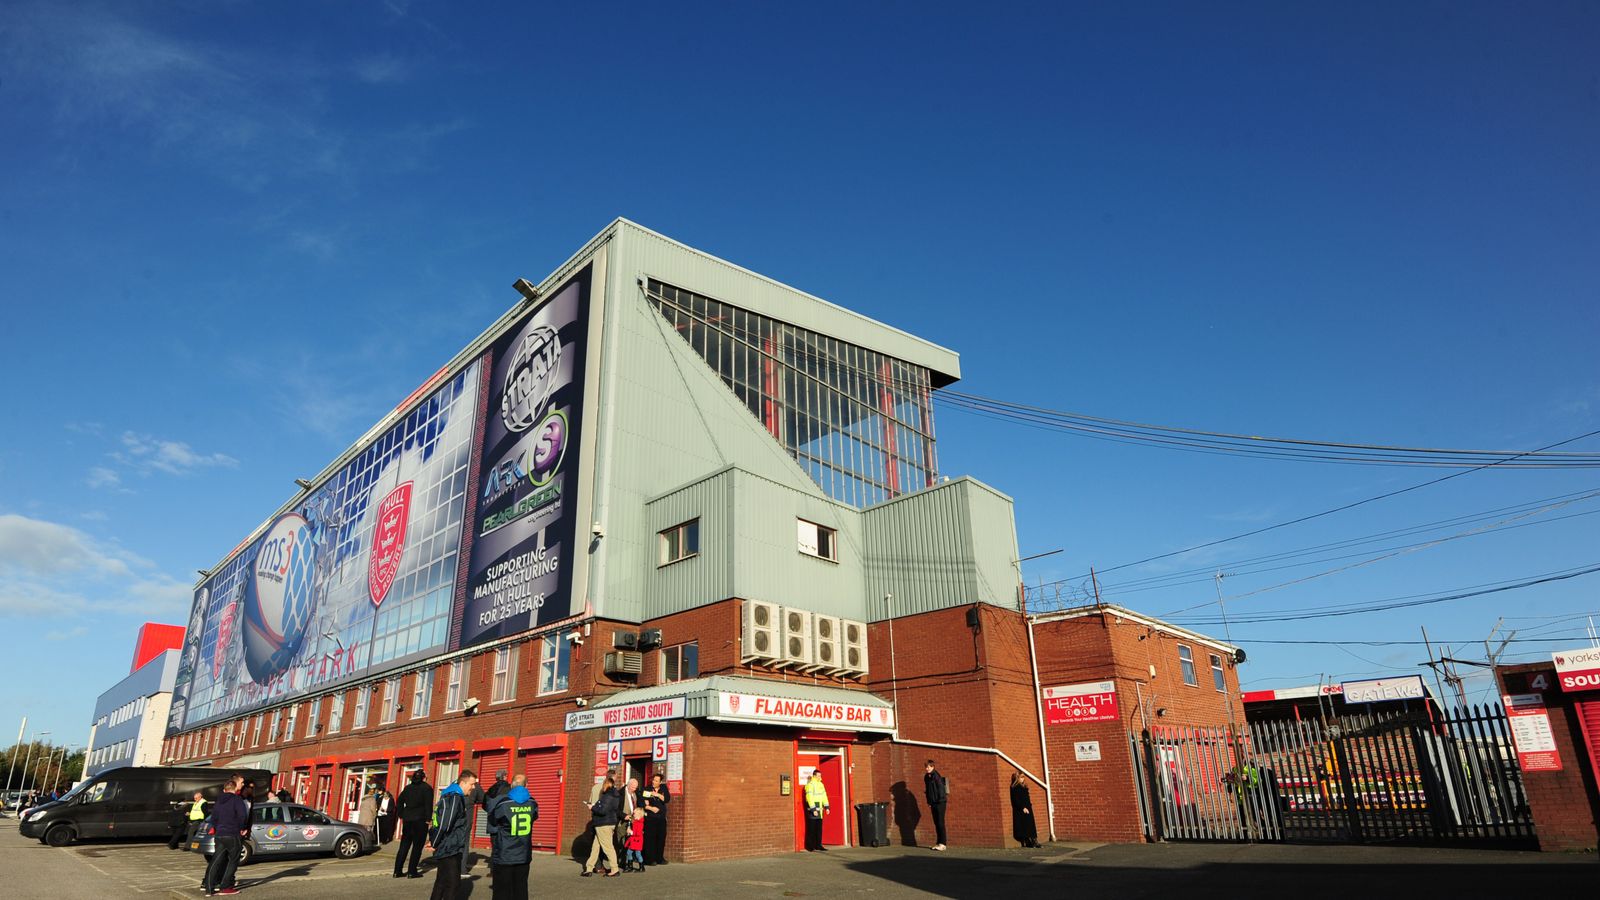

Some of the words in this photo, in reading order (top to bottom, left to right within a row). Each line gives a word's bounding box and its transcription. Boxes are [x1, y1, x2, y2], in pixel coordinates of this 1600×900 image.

[502, 334, 562, 419] STRATA
[384, 488, 405, 512] HULL
[482, 480, 562, 532] PEARLGREEN
[486, 546, 546, 582] SUPPORTING
[473, 556, 558, 600] MANUFACTURING
[493, 591, 505, 607] IN
[507, 582, 532, 602] HULL
[479, 609, 498, 626] FOR
[499, 604, 512, 620] 25
[514, 592, 545, 615] YEARS
[1532, 674, 1549, 690] 4
[1564, 674, 1600, 688] SOU
[604, 709, 621, 724] WEST
[623, 705, 646, 721] STAND
[648, 702, 673, 718] SOUTH
[755, 697, 843, 720] FLANAGAN'S
[847, 706, 872, 723] BAR
[1048, 693, 1113, 710] HEALTH
[620, 727, 641, 737] SEATS
[610, 745, 618, 761] 6
[656, 741, 664, 758] 5
[511, 813, 532, 836] 13
